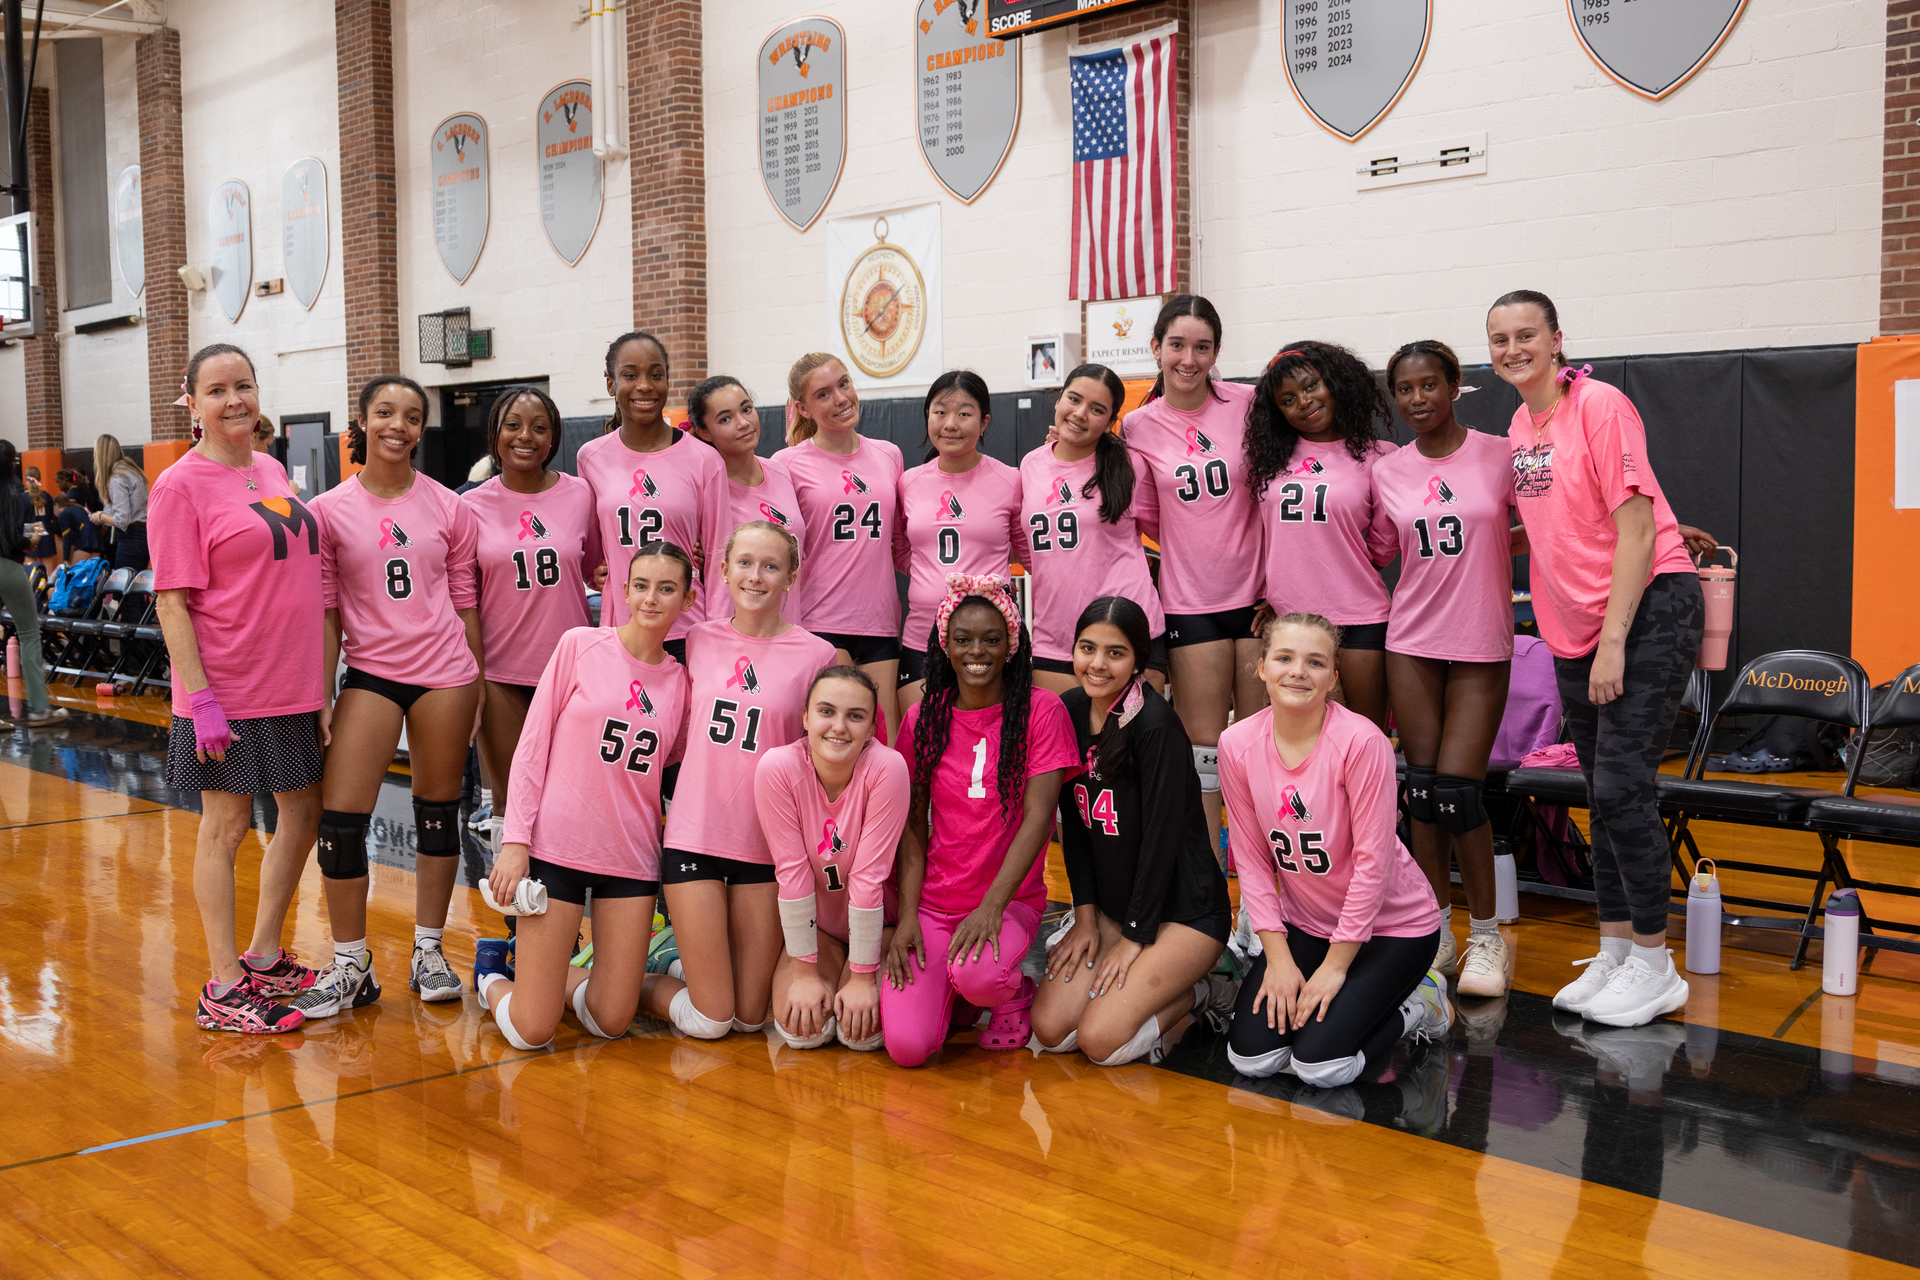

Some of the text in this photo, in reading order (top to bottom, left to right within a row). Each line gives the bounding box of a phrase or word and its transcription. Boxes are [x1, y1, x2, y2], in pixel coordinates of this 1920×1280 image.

[1295, 1, 1318, 15] 1990
[1295, 9, 1351, 30] 1996 2015
[1582, 12, 1610, 27] 1995
[991, 9, 1032, 32] SCORE
[1295, 23, 1353, 45] 1997 2022
[769, 30, 831, 66] WRESTLING
[927, 40, 1005, 71] CHAMPIONS
[1295, 38, 1353, 59] 1998 2023
[1295, 53, 1352, 74] 1999 2024
[923, 70, 962, 86] 1962 1983
[767, 83, 833, 113] CHAMPIONS
[923, 83, 962, 98] 1963 1984
[804, 105, 818, 116] 2012
[923, 101, 940, 111] 1964
[924, 113, 940, 124] 1976
[444, 123, 481, 145] LACROSSE
[784, 133, 798, 143] 1974
[804, 128, 819, 139] 2014
[924, 125, 940, 136] 1977
[925, 133, 963, 148] 1981 1999
[545, 135, 593, 158] CHAMPIONS
[784, 144, 800, 155] 2000
[946, 145, 965, 157] 2000
[784, 155, 799, 166] 2001
[805, 162, 821, 173] 2020
[437, 166, 480, 187] CHAMPIONS
[1092, 346, 1152, 358] EXPECT RESPEC
[1174, 458, 1231, 503] 30
[1279, 482, 1329, 523] 21
[248, 496, 320, 561] M
[616, 505, 665, 549] 12
[833, 501, 882, 541] 24
[1029, 510, 1079, 552] 29
[937, 526, 960, 565] 0
[1413, 514, 1464, 559] 13
[384, 557, 413, 601] 8
[511, 546, 561, 590] 18
[1745, 669, 1848, 697] McDonogh
[707, 697, 763, 754] 51
[599, 716, 660, 775] 52
[968, 737, 986, 798] 1
[1073, 783, 1120, 836] 94
[1268, 828, 1332, 875] 25
[822, 863, 845, 892] 1
